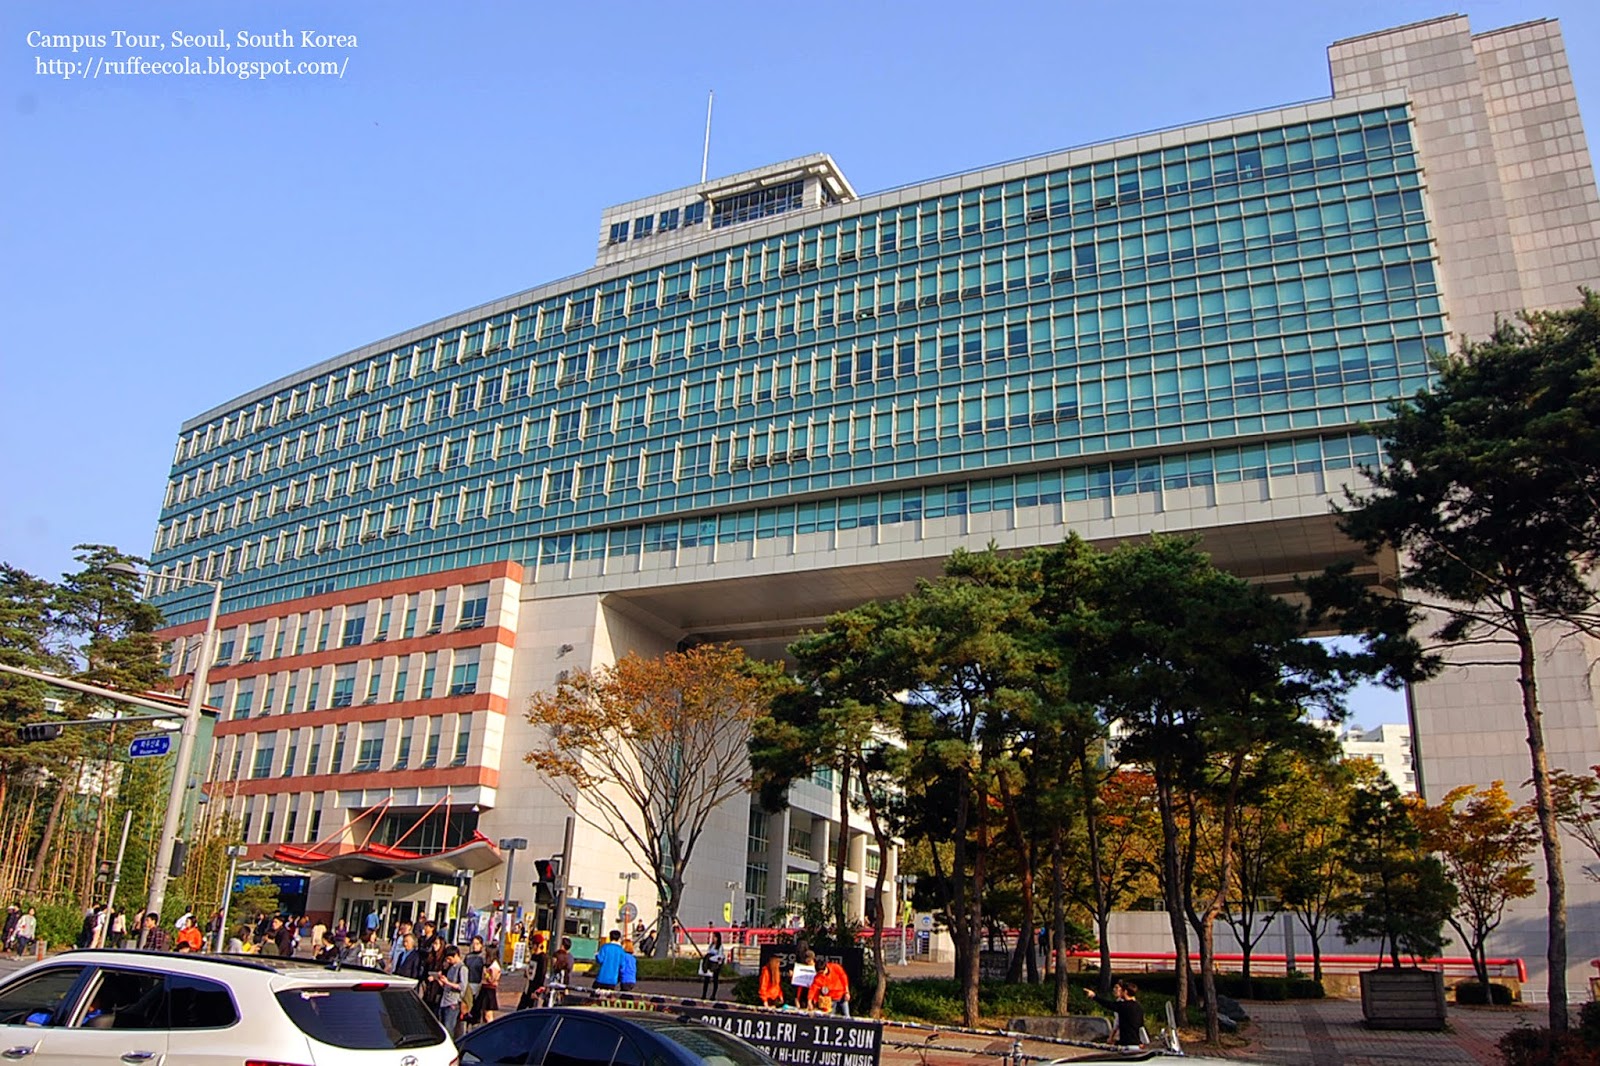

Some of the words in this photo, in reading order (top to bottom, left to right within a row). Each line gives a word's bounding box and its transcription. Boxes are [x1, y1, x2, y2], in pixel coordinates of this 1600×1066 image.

[813, 1025, 875, 1050] 11.2.SUN
[779, 1047, 811, 1064] HI-LITE
[819, 1051, 842, 1066] JUST
[843, 1053, 873, 1066] MUSIC
